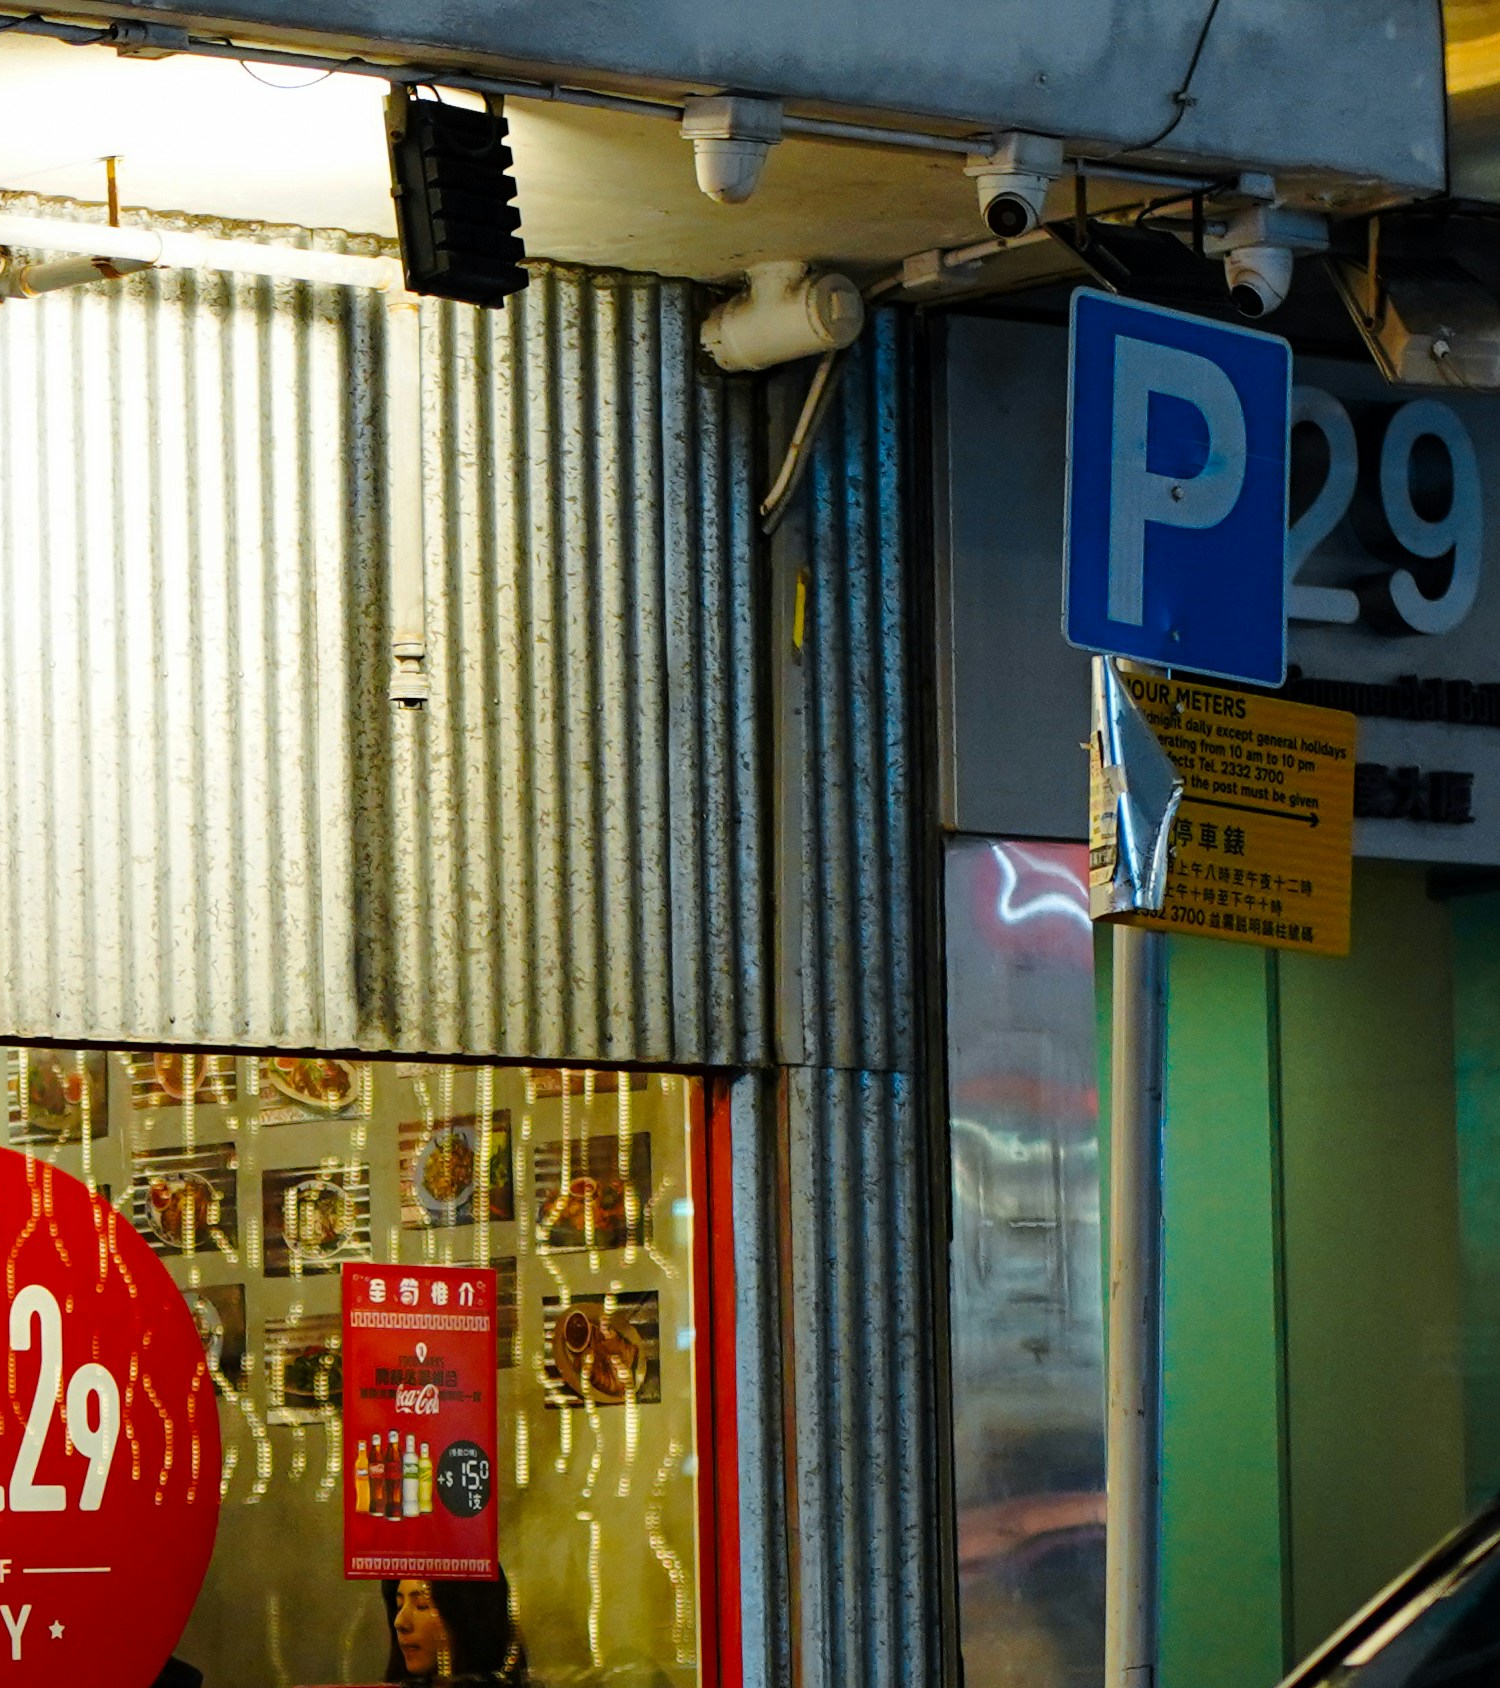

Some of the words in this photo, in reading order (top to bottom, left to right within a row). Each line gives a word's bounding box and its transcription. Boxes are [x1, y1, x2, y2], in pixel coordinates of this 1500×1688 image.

[1107, 335, 1248, 627] P
[1288, 385, 1483, 636] 29
[1128, 678, 1170, 706] OUR
[1175, 687, 1247, 719] METERS
[1185, 719, 1212, 737] daily
[1216, 726, 1253, 743] except
[1257, 731, 1298, 751] general
[1301, 735, 1347, 760] holidays
[1201, 738, 1226, 757] from
[1230, 743, 1242, 758] 10
[1246, 750, 1263, 762] am
[1266, 751, 1278, 766] to
[1282, 755, 1294, 769] 10
[1298, 760, 1316, 773] pm
[1221, 761, 1251, 780] 2332
[1254, 767, 1284, 785] 3700
[1191, 777, 1209, 790] the
[1213, 779, 1237, 797] post
[1240, 785, 1269, 800] must
[1272, 788, 1287, 803] be
[1289, 792, 1319, 809] given
[1170, 905, 1206, 926] 3700
